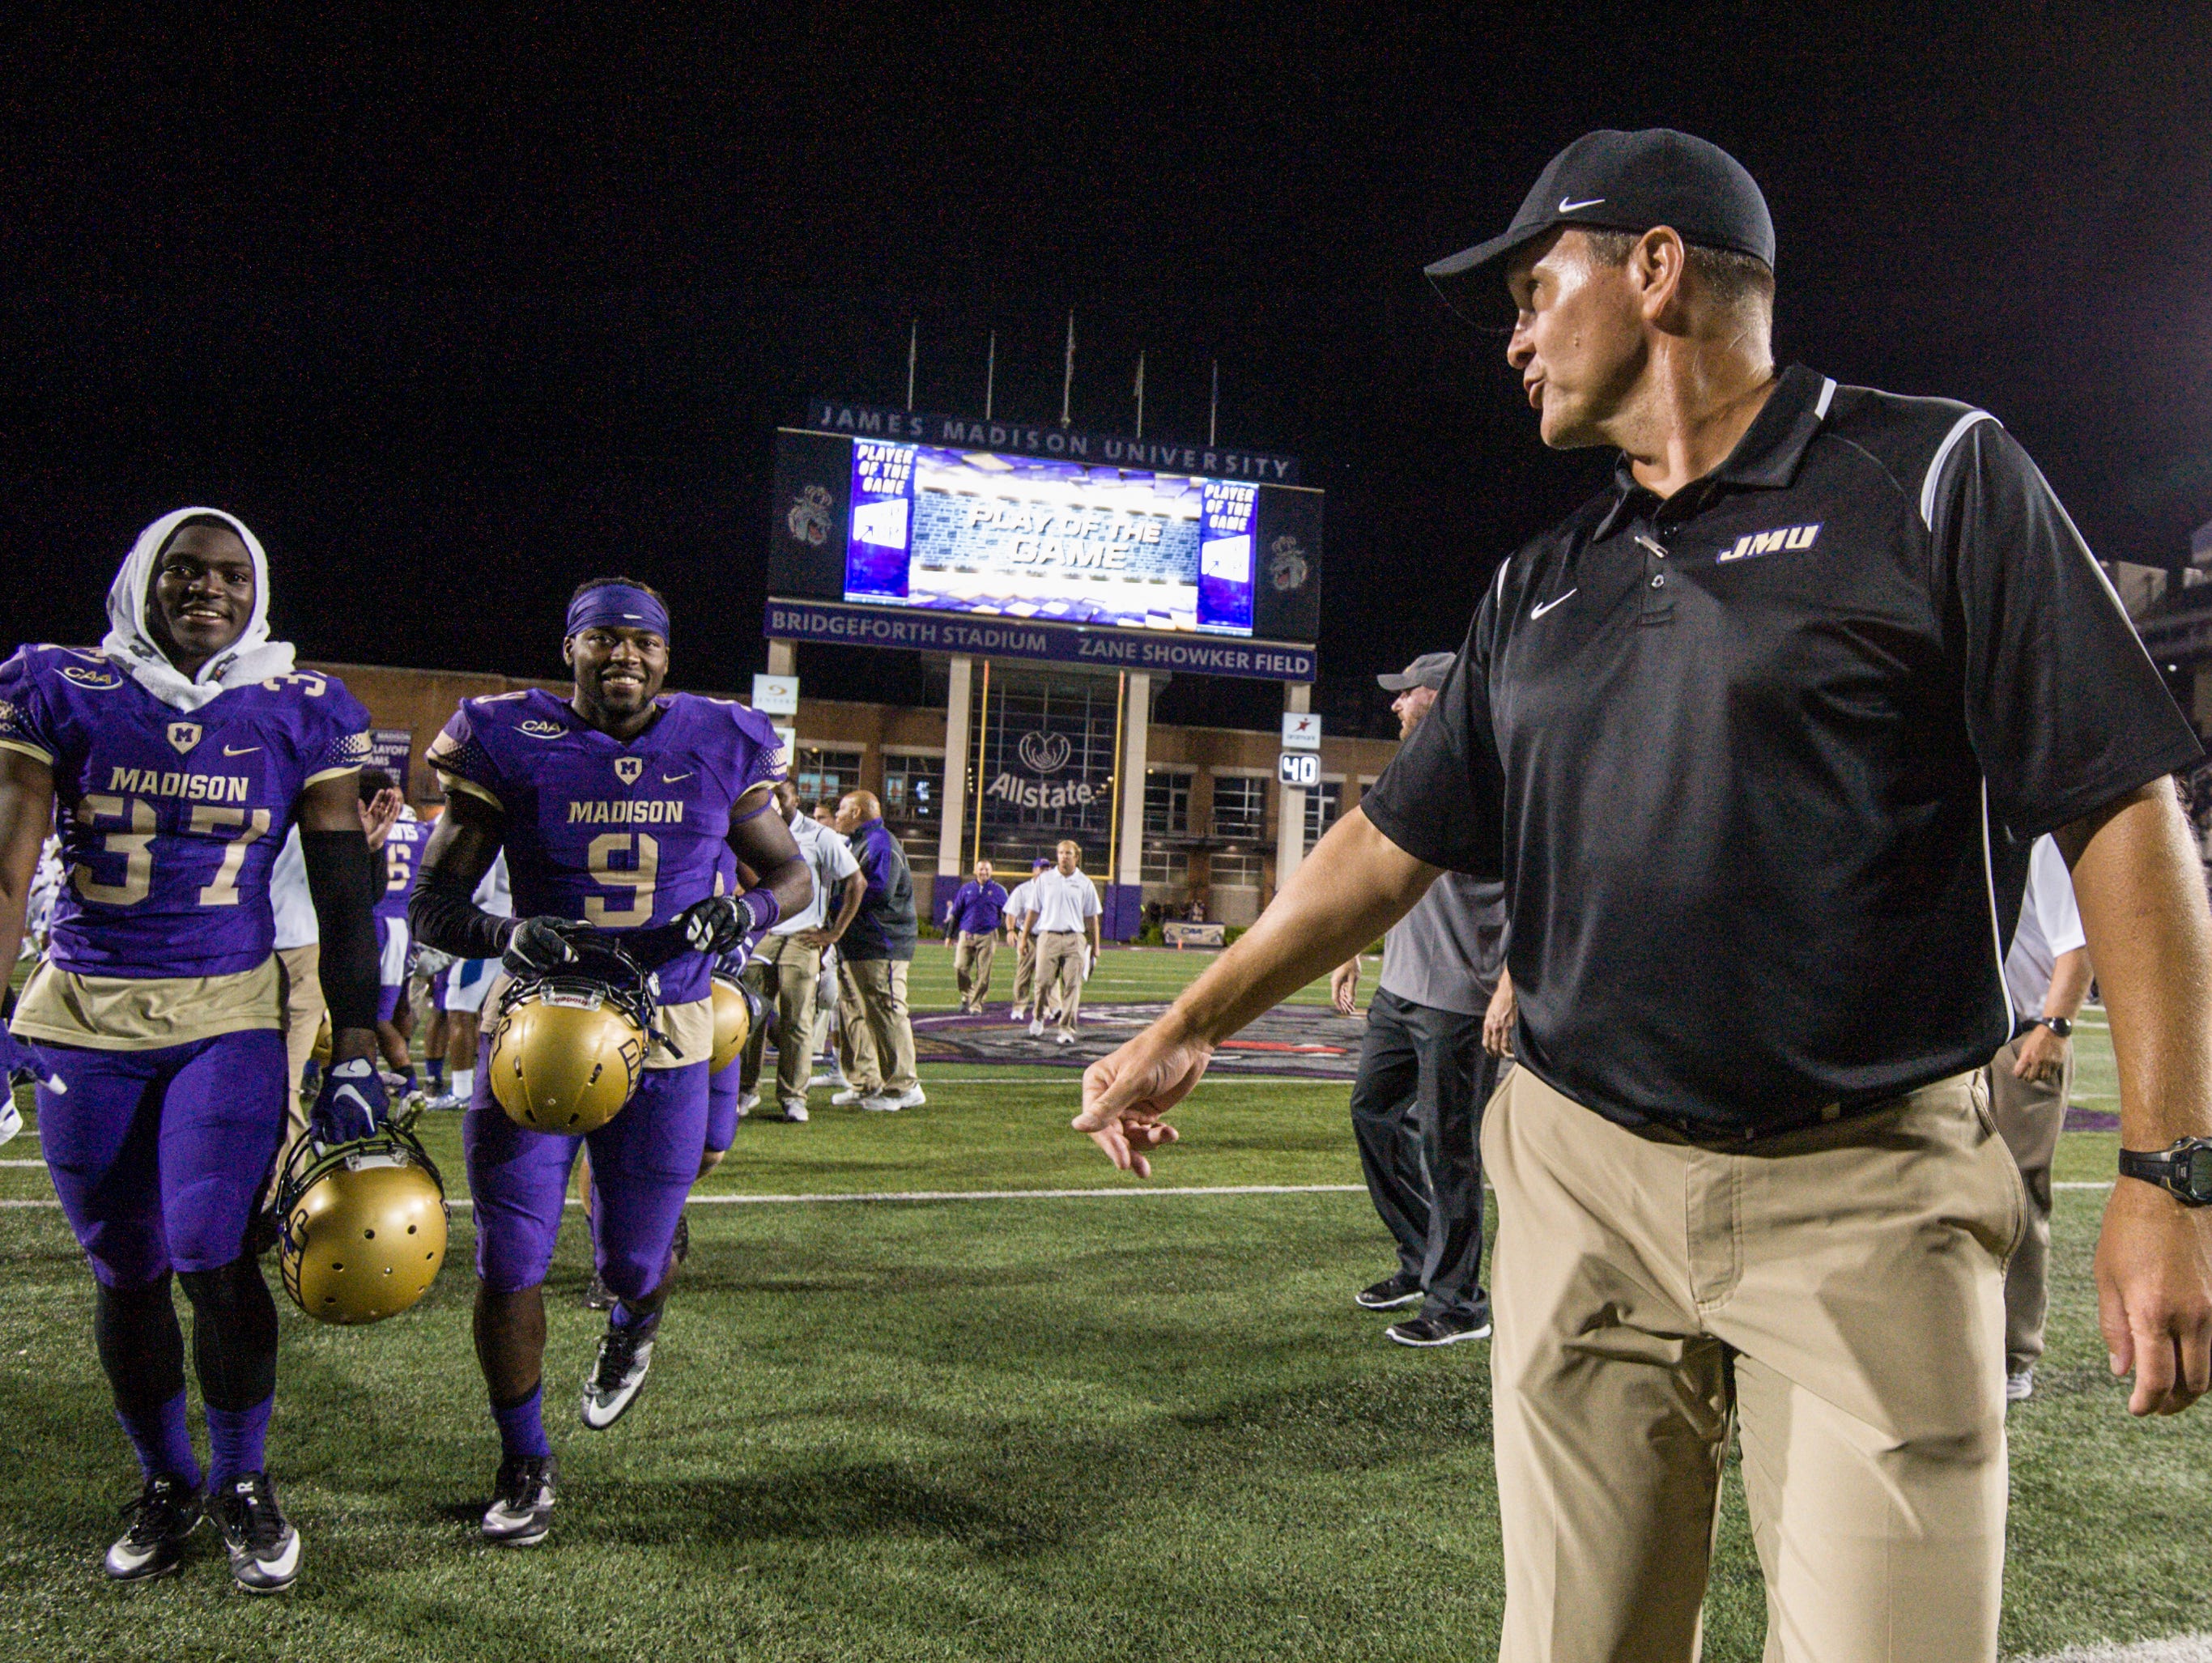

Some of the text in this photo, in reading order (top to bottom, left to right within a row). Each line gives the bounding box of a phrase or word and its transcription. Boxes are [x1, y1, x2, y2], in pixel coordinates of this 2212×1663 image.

[820, 406, 1289, 478] JAMES MADISON UNIVERSITY
[857, 444, 914, 465] PLAYER
[858, 461, 911, 480] OF THE
[862, 476, 905, 495] GAME
[1204, 484, 1255, 502] PLAYER
[1206, 499, 1253, 517] OF THE
[972, 508, 1163, 545] PLAY OF THE
[1209, 514, 1248, 531] GAME
[1012, 538, 1131, 570] GAME
[1720, 525, 1819, 561] JMU
[772, 610, 1047, 652] BRIDGEFORTH STADIUM
[1078, 638, 1310, 674] ZANE SHOWKER FIELD
[64, 666, 112, 684] CAA
[175, 728, 194, 742] M
[521, 720, 561, 733] CAA
[620, 761, 636, 775] M
[1283, 756, 1317, 783] 40
[108, 767, 249, 802] MADISON
[986, 772, 1092, 808] Allstate
[567, 800, 683, 823] MADISON
[78, 794, 270, 905] 37
[585, 832, 658, 928] 9
